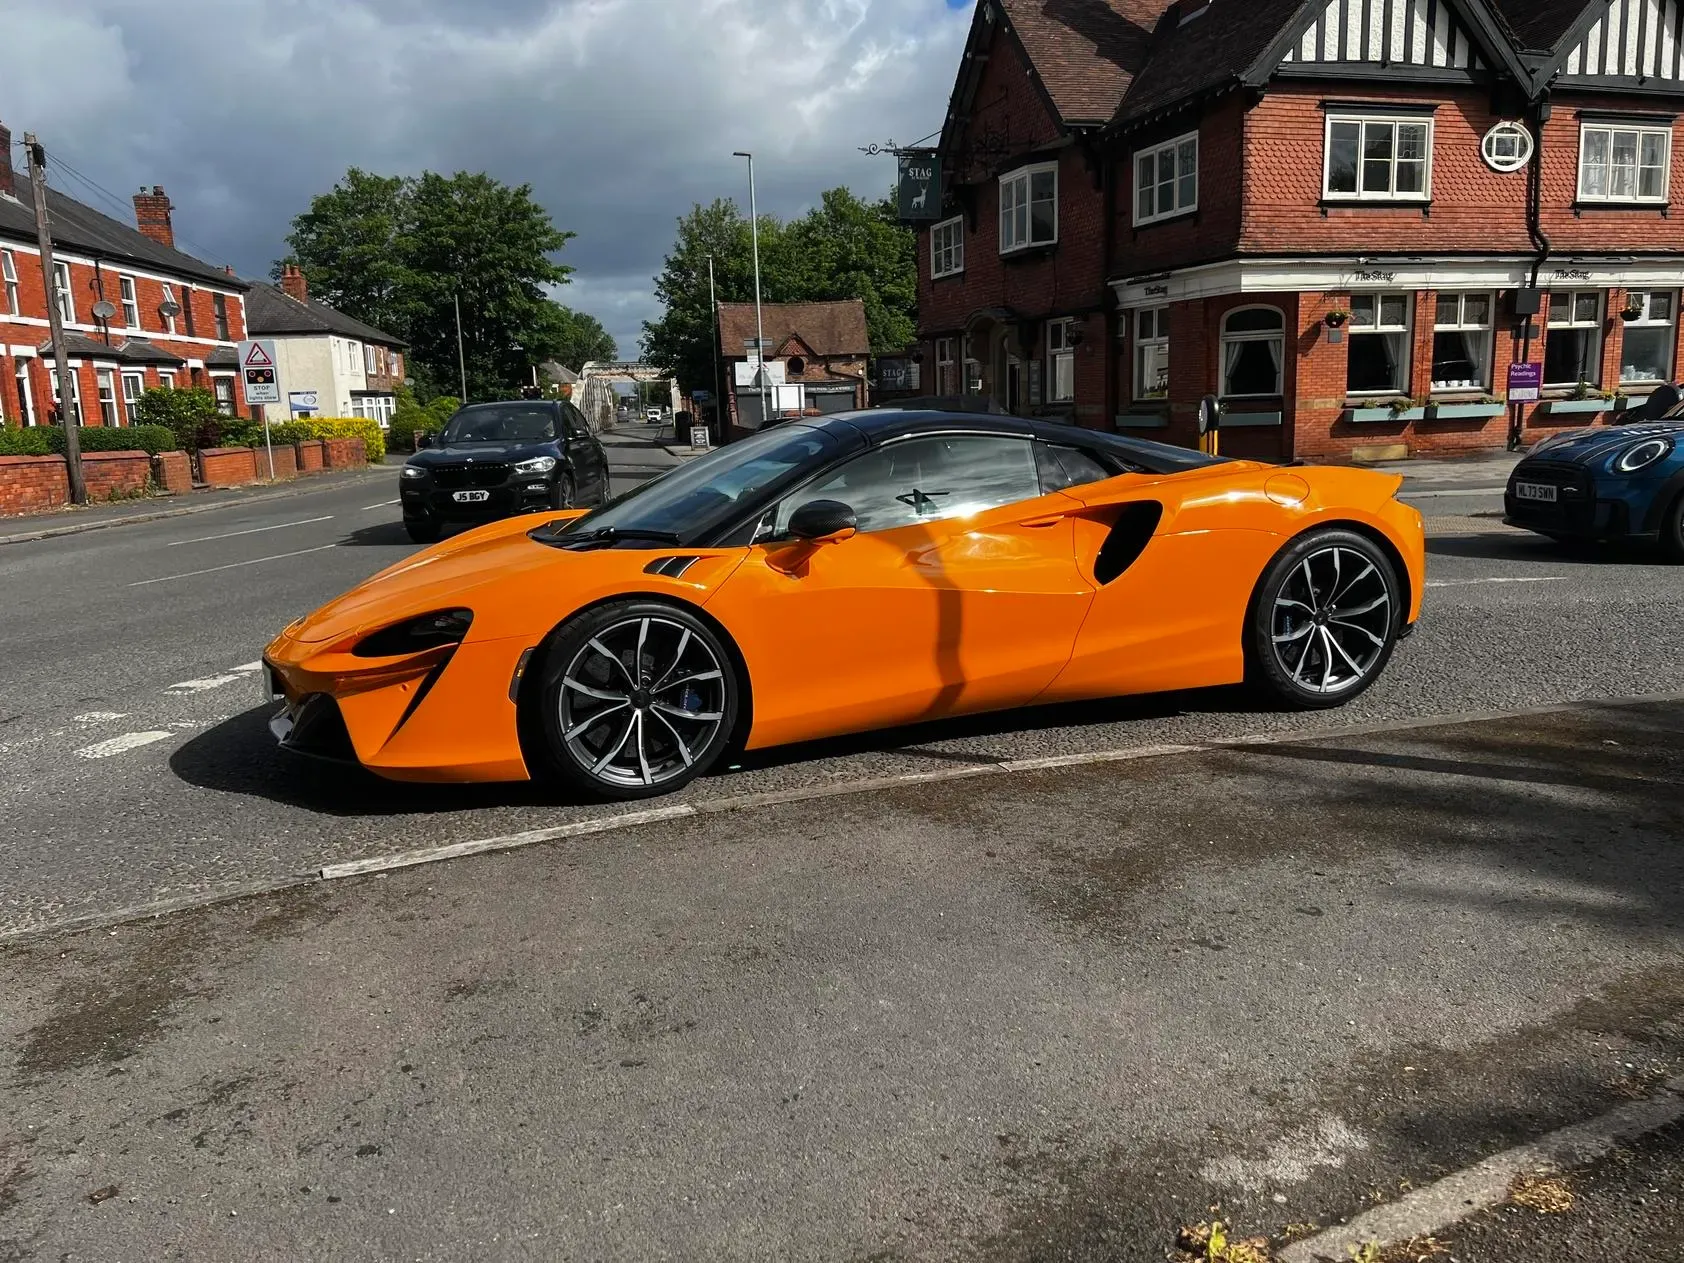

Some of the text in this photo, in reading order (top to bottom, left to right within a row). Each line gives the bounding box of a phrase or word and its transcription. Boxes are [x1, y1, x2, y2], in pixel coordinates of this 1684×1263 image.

[908, 167, 932, 177] STAG
[883, 369, 901, 377] STAG
[469, 491, 486, 501] BGY
